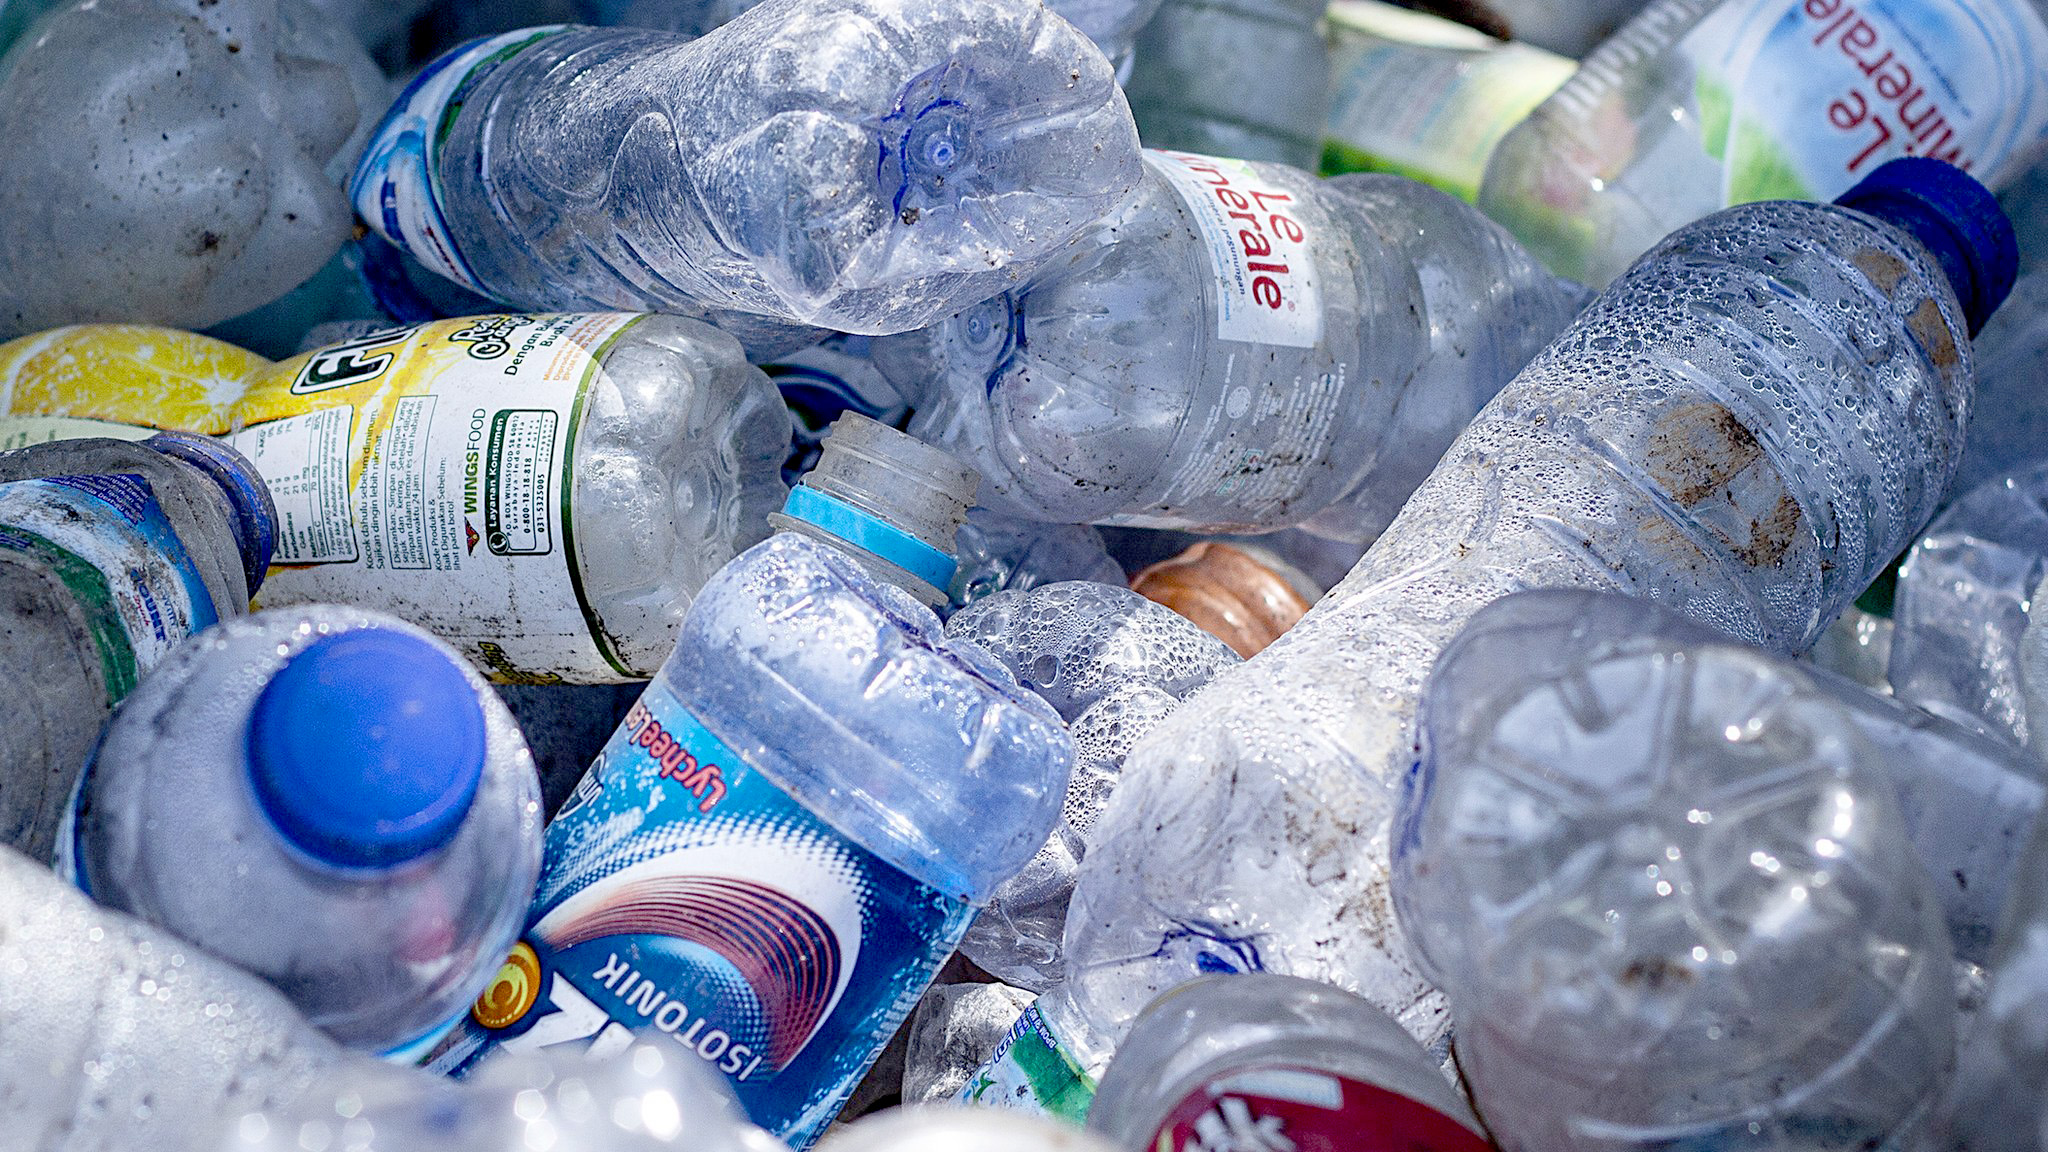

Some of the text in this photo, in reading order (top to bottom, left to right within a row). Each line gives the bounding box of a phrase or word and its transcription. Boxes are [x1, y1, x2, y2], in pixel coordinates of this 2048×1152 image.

[1829, 90, 1891, 171] Le
[1153, 148, 1289, 310] inerale
[1249, 189, 1304, 244] Le
[1221, 228, 1246, 296] pegunungan
[540, 324, 570, 347] Buah
[504, 328, 543, 376] Dengan
[398, 401, 409, 421] yang
[409, 400, 423, 438] habiskan
[391, 425, 401, 456] tempat
[407, 440, 415, 457] dan
[303, 467, 310, 480] mg
[389, 461, 396, 470] di
[406, 459, 412, 468] es
[464, 409, 486, 514] WINGSFOOD
[489, 418, 503, 527] Layanan Konsumen
[505, 451, 513, 499] WINGSFOOD
[283, 487, 290, 495] 21
[293, 485, 300, 493] 21
[302, 483, 308, 493] 20
[360, 456, 369, 499] sebelum
[370, 472, 378, 497] lebih
[388, 474, 397, 507] Simpan
[412, 493, 420, 504] 24
[522, 458, 532, 534] 0-800-18-18-818
[536, 474, 544, 533] 031-5325005
[360, 502, 369, 537] dahulu
[371, 500, 380, 532] dingin
[397, 516, 405, 533] dan
[413, 507, 421, 534] waktu
[429, 508, 439, 546] Produksi
[438, 502, 449, 551] Digunakan
[373, 535, 385, 570] Sajikan
[399, 541, 409, 563] sejuk
[407, 531, 417, 563] simpan
[416, 536, 425, 564] dalam
[449, 527, 459, 549] pada
[362, 539, 374, 569] Kocok
[433, 548, 442, 571] Kode
[442, 552, 452, 570] Baik
[592, 952, 762, 1082] ISOTONIK
[1038, 1025, 1057, 1049] BPOM
